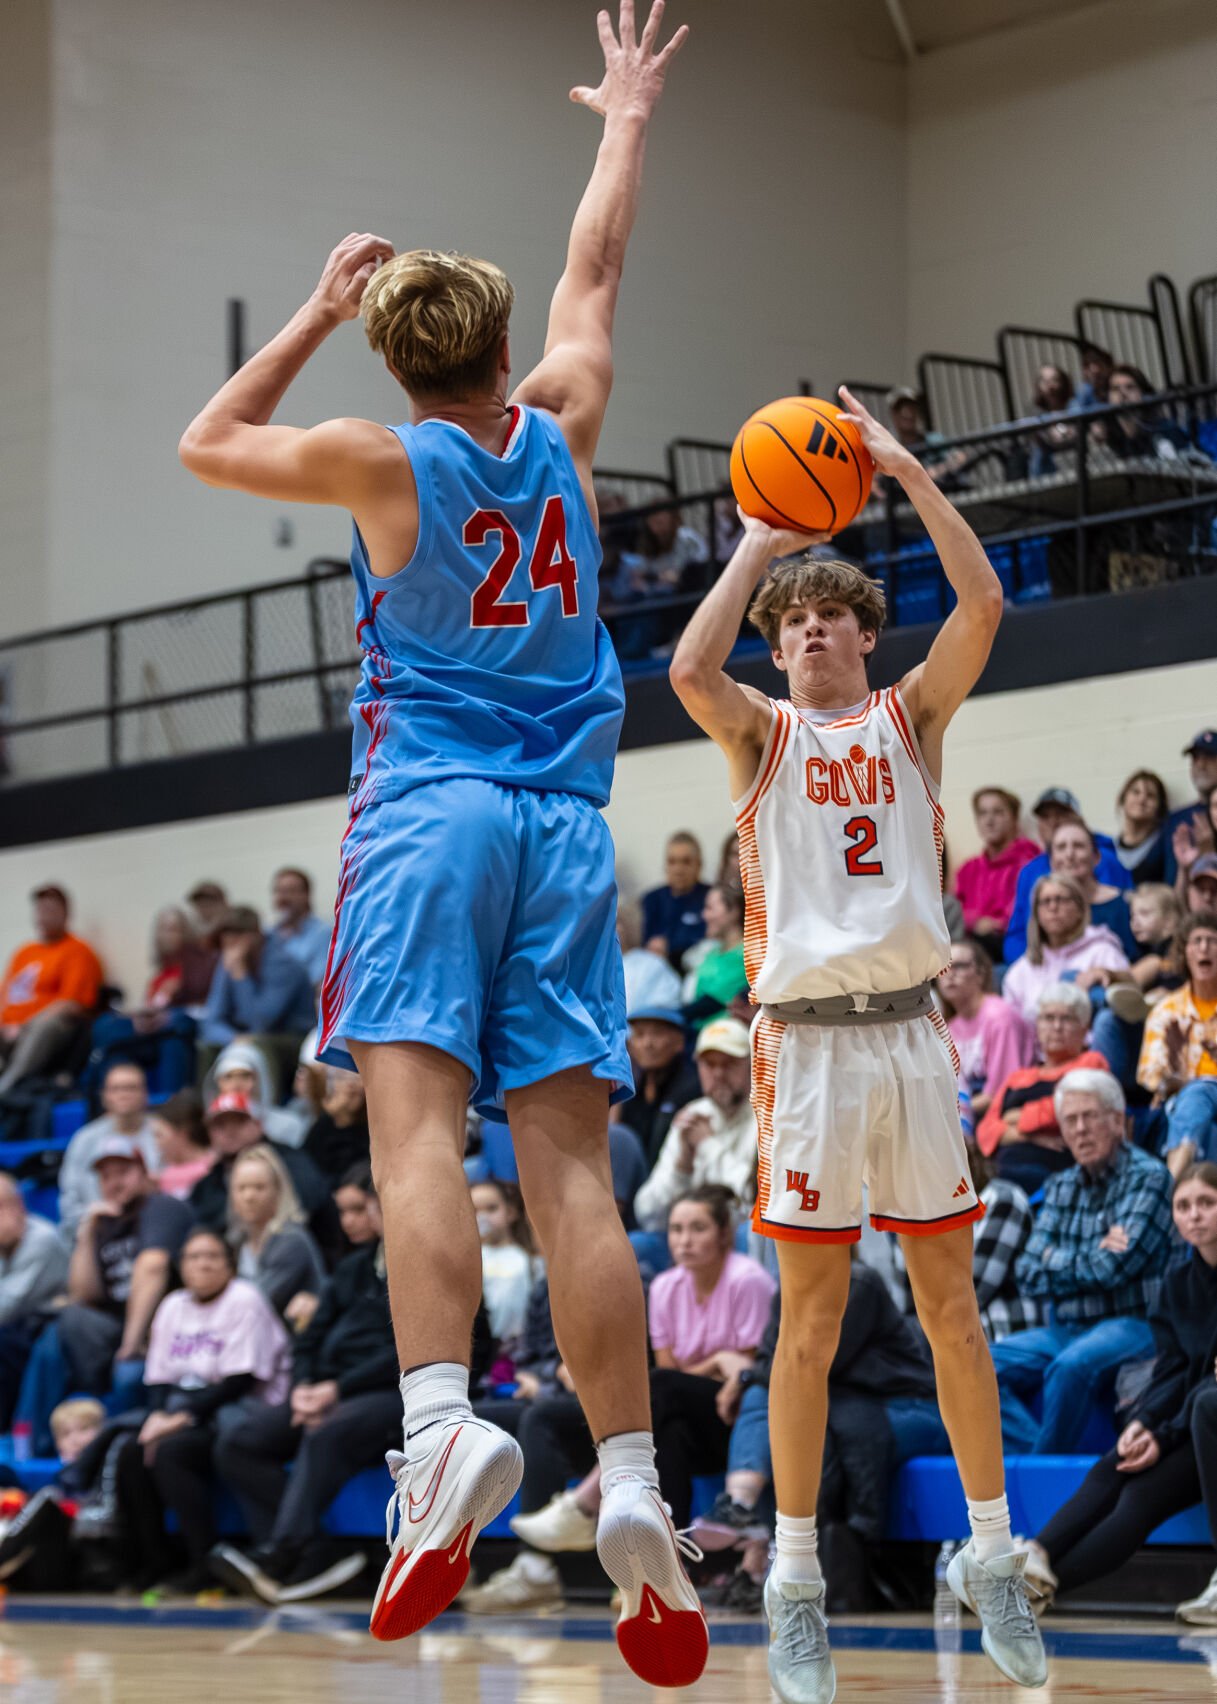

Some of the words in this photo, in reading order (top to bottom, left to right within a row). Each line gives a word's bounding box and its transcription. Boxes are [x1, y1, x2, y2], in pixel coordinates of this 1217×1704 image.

[462, 494, 580, 629] 24
[805, 755, 896, 807] GOVS
[844, 815, 884, 877] 2
